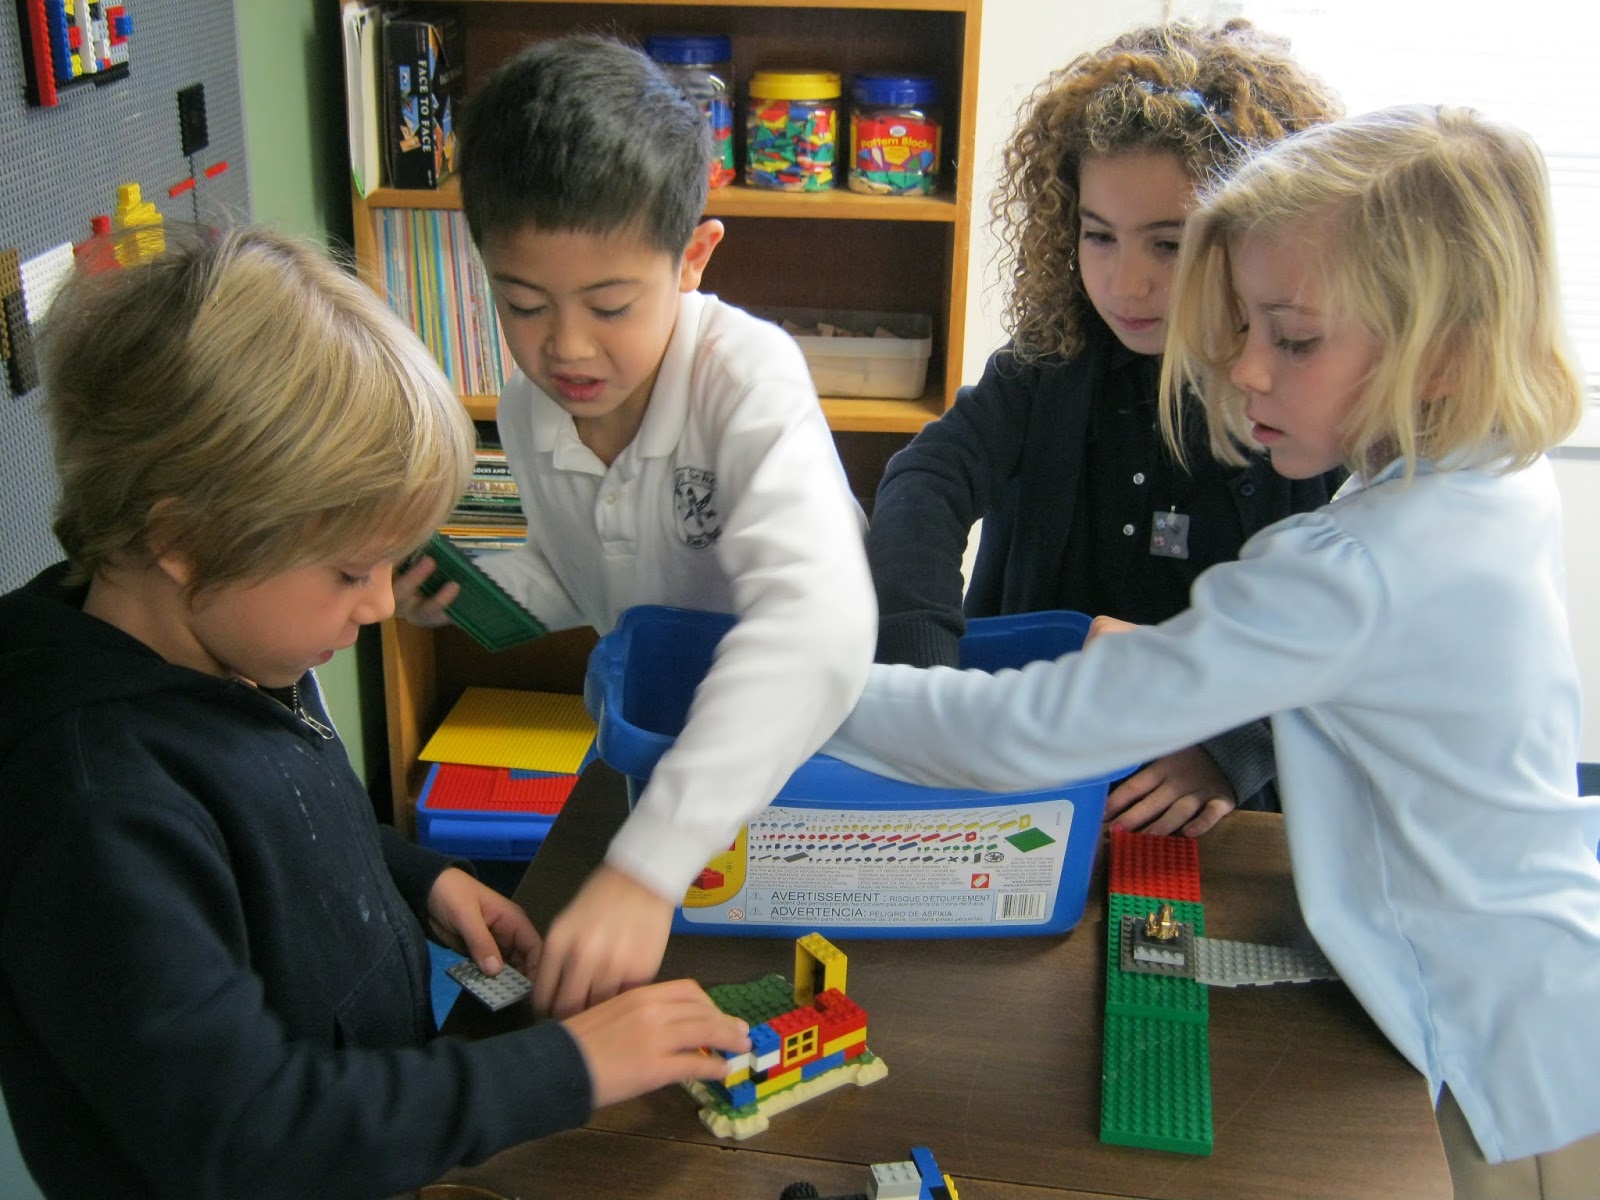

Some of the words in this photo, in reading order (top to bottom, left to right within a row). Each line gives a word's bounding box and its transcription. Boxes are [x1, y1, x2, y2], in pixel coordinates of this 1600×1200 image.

[418, 60, 429, 93] FACE
[420, 97, 430, 116] TO
[421, 120, 432, 153] FACE
[771, 891, 881, 903] AVERTISSEMENT
[890, 895, 920, 903] RISQUE
[770, 906, 867, 917] ADVERTENCIA:
